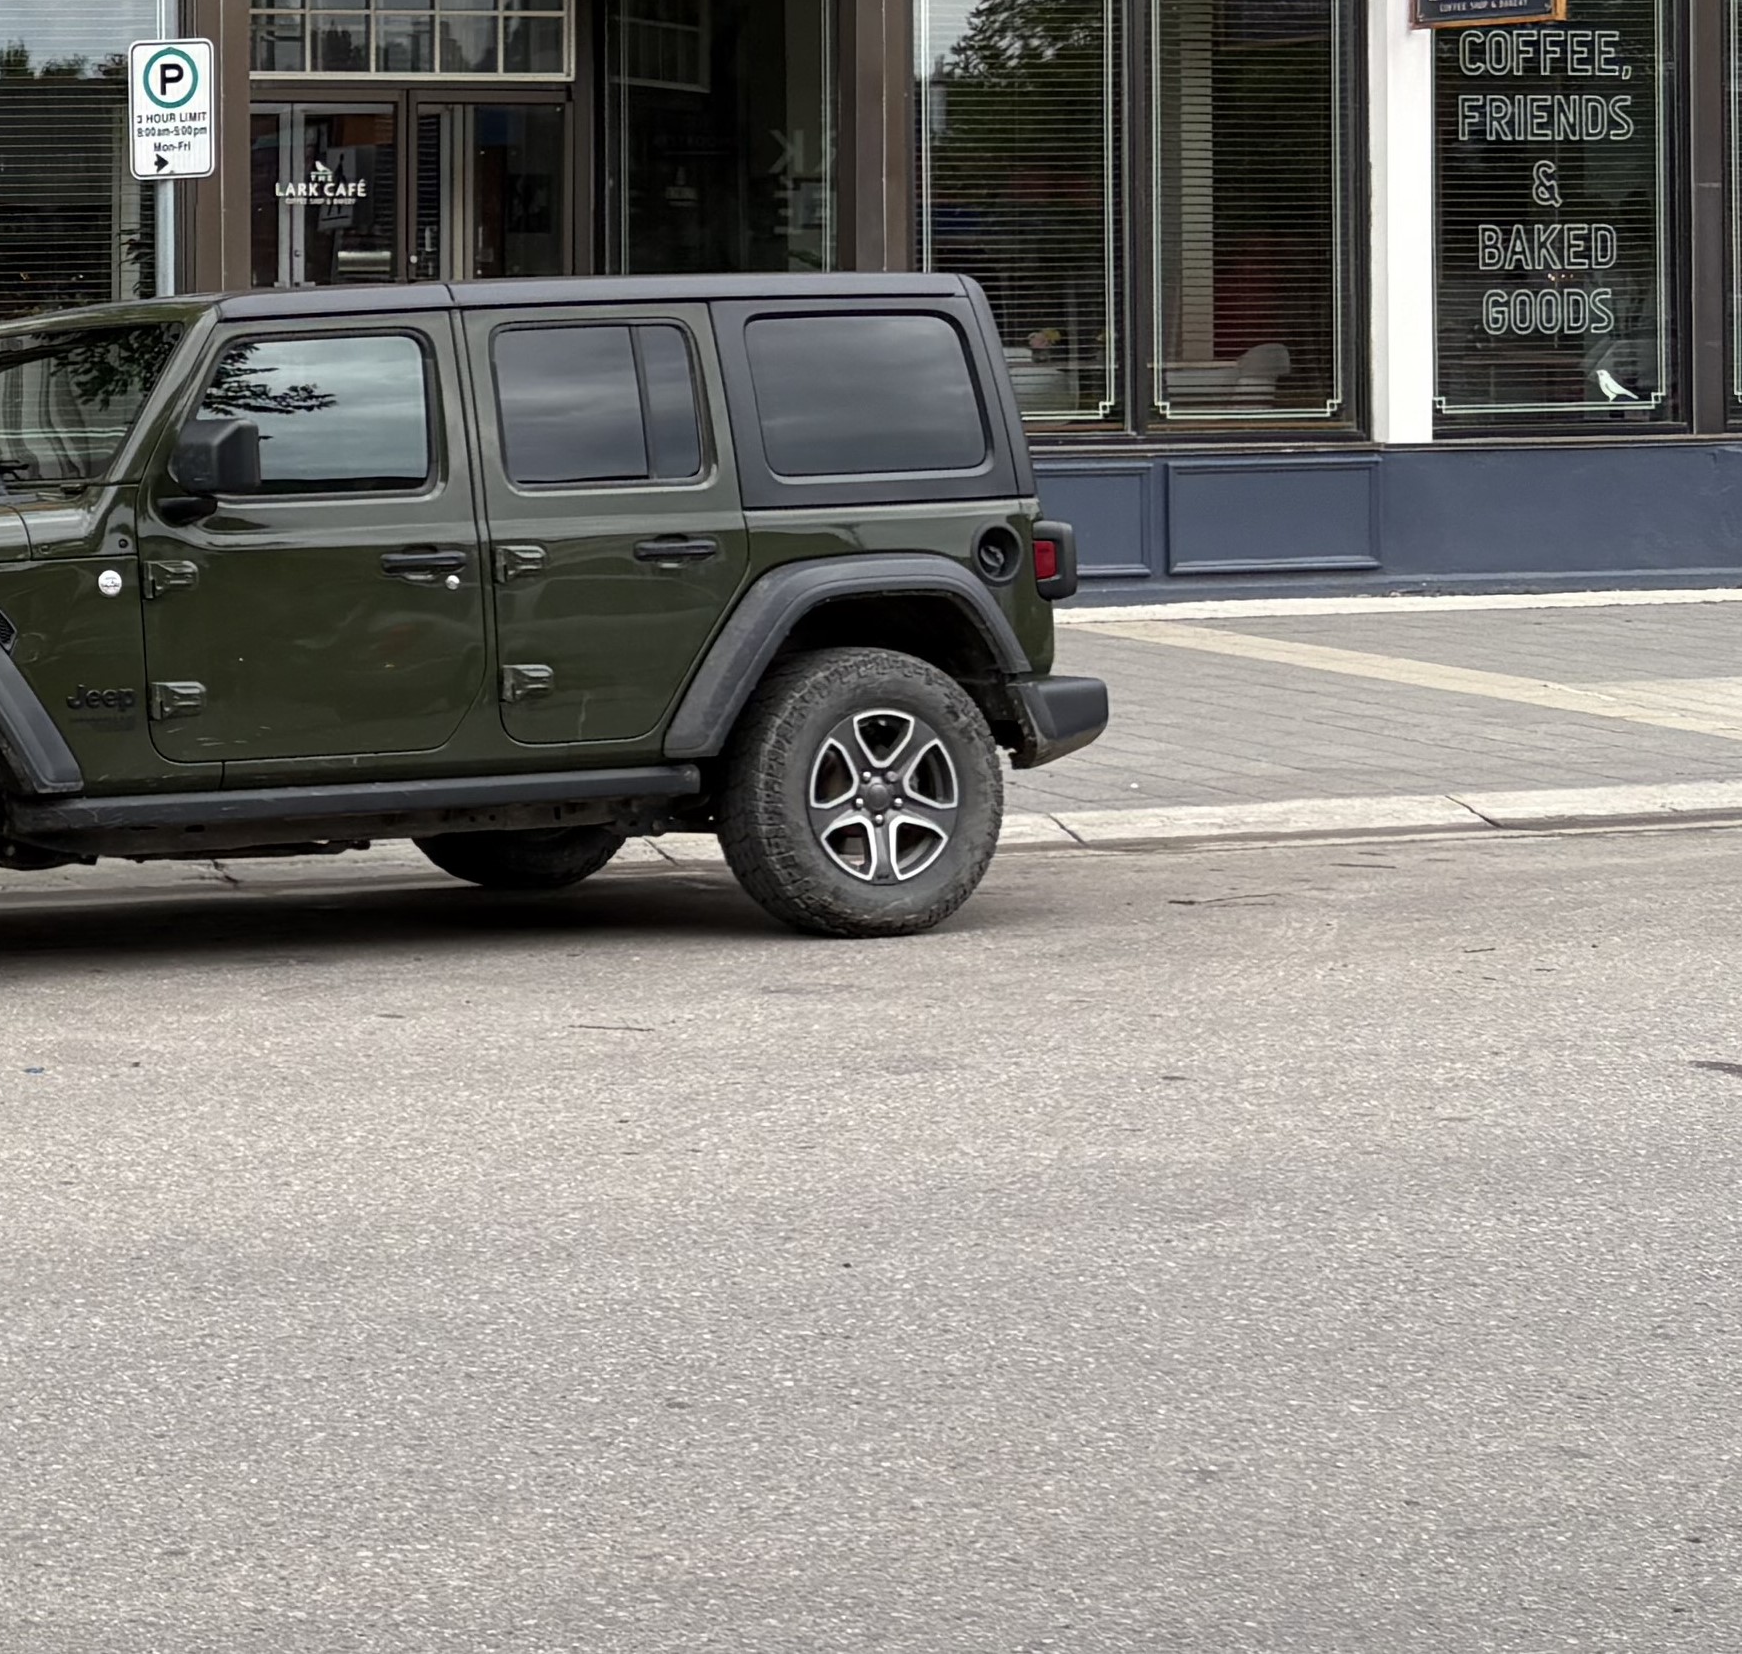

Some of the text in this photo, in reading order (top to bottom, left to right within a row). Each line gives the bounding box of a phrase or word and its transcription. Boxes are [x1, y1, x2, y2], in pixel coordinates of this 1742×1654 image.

[1458, 30, 1633, 80] COFFEE,
[159, 63, 185, 96] P
[146, 112, 177, 124] HOUR
[179, 111, 208, 123] LIMIT
[1457, 94, 1635, 141] FRIENDS
[274, 178, 368, 198] LARK CAFÉ
[1531, 159, 1563, 208] &
[1477, 223, 1617, 270] BAKED
[1482, 287, 1615, 335] GOODS
[66, 683, 136, 713] Jeep
